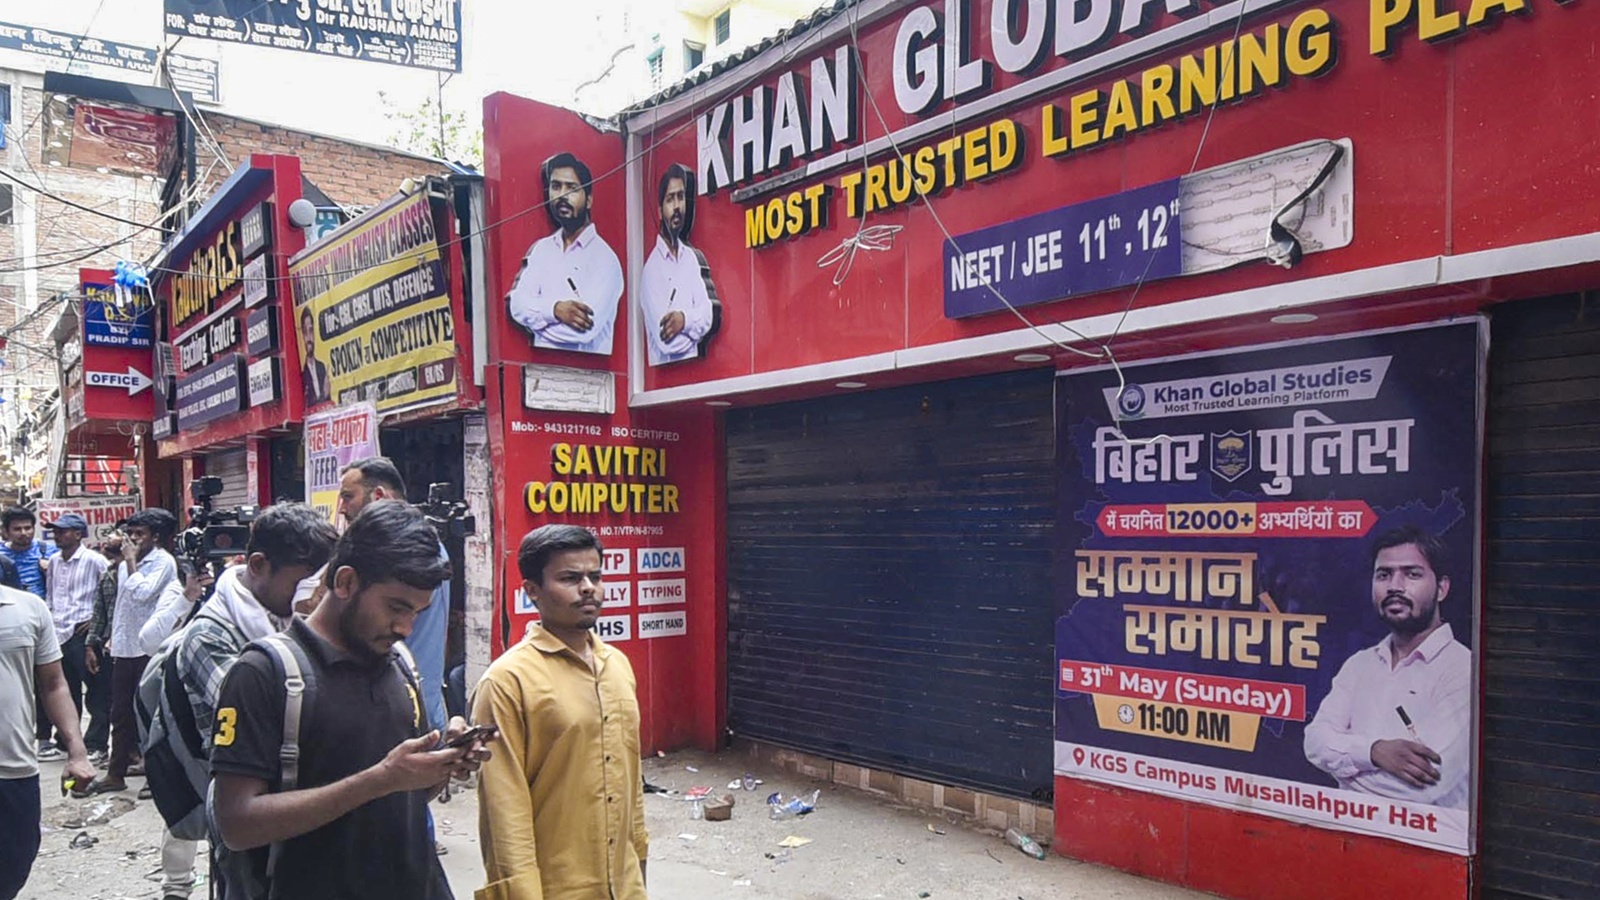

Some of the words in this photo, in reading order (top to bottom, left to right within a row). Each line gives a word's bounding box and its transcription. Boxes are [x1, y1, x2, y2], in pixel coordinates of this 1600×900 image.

[166, 13, 186, 29] FOR:
[316, 10, 336, 25] Dir
[339, 14, 407, 36] RAUSHAN
[410, 25, 459, 43] ANAND
[696, 45, 850, 196] KHAN
[744, 183, 828, 249] MOST
[840, 117, 1018, 219] TRUSTED
[1041, 8, 1331, 158] LEARNING
[388, 198, 435, 259] CLASSES
[950, 243, 1005, 293] NEET
[1022, 230, 1063, 277] JEE
[393, 266, 435, 304] DEFENCE
[88, 334, 129, 344] PRADIP
[131, 337, 150, 346] SIR
[330, 336, 363, 377] SPOKEN
[370, 305, 455, 363] COMPETITIVE
[91, 373, 140, 387] OFFICE
[1154, 386, 1205, 405] Khan
[1209, 375, 1276, 399] Global
[1283, 365, 1372, 390] Studies
[1164, 402, 1190, 414] Most
[1193, 399, 1236, 412] Trusted
[1239, 392, 1290, 410] Learning
[1294, 386, 1349, 403] Platform
[511, 421, 542, 433] Mob:-
[544, 422, 602, 436] 9431217162
[611, 427, 629, 437] ISO
[630, 426, 680, 441] CERTIFIED
[553, 443, 667, 477] SAVITRI
[1092, 426, 1204, 484] बिहार
[1257, 409, 1415, 496] पुलिस
[310, 456, 338, 486] FFER
[526, 481, 680, 514] COMPUTER
[39, 506, 136, 527] SHTHAND
[584, 526, 599, 536] EG.
[1106, 507, 1117, 531] में
[1119, 507, 1164, 531] चयनित
[1167, 510, 1254, 531] 12000+
[1258, 504, 1334, 531] अभ्यर्थियों
[1337, 509, 1362, 530] का
[602, 553, 624, 570] TP
[642, 552, 681, 569] ADCA
[1074, 550, 1258, 605] सम्मान
[603, 587, 627, 602] LLY
[642, 586, 682, 599] TYPING
[642, 620, 664, 632] SHORT
[665, 618, 684, 629] HAND
[1123, 591, 1327, 670] समारोह
[1081, 665, 1113, 689] 31th
[1119, 672, 1167, 700] May
[1174, 677, 1292, 717] (Sunday)
[214, 707, 238, 746] 3
[1138, 703, 1189, 737] 11:00
[1196, 711, 1231, 743] AM
[1090, 752, 1128, 774] KGS
[1134, 759, 1217, 791] Campus
[1224, 775, 1379, 822] Musallahpur
[1389, 804, 1438, 834] Hat
